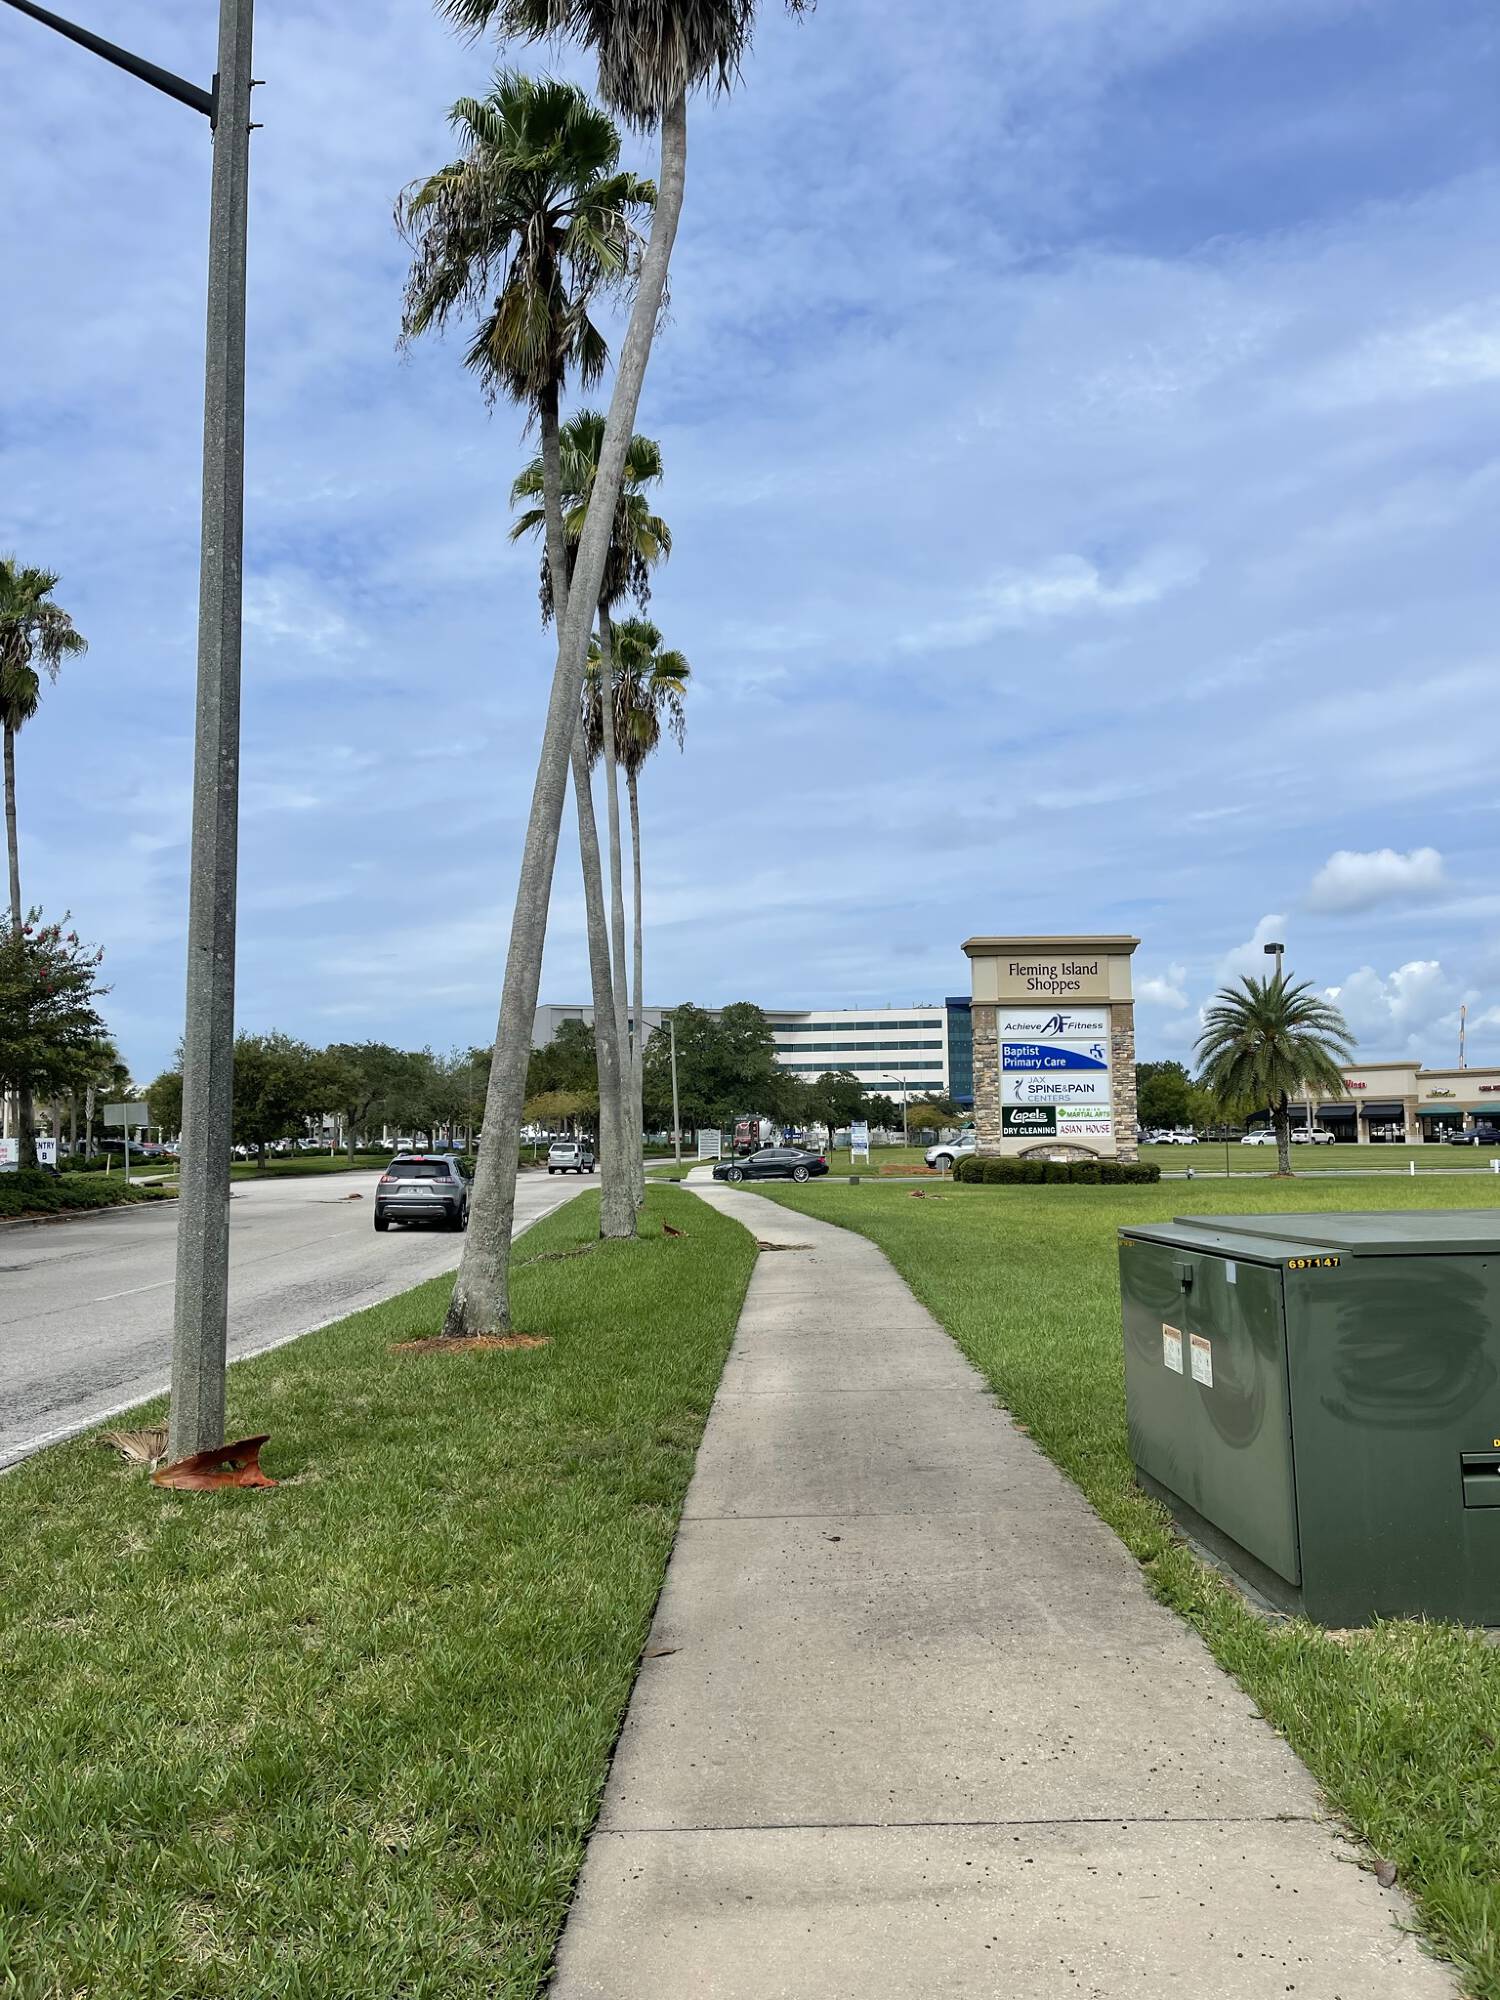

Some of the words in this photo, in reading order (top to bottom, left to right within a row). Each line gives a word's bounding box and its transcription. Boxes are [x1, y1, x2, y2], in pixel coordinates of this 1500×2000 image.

[1009, 963, 1058, 980] Fleming
[1061, 962, 1098, 976] Island
[1027, 977, 1081, 995] Shoppes
[1004, 1023, 1042, 1031] Achieve
[1003, 1046, 1040, 1057] Baptist
[1004, 1057, 1042, 1069] Primary
[1044, 1057, 1067, 1067] Care
[1028, 1076, 1046, 1084] JAX
[1027, 1094, 1071, 1102] CENTERS
[1010, 1108, 1048, 1124] Lapels
[1003, 1127, 1018, 1135] DRY
[1019, 1126, 1056, 1134] CLEANING
[1060, 1124, 1082, 1134] ASIAN
[1085, 1124, 1110, 1134] HOUSE
[37, 1141, 55, 1150] NTRY
[1288, 1257, 1339, 1269] 697147
